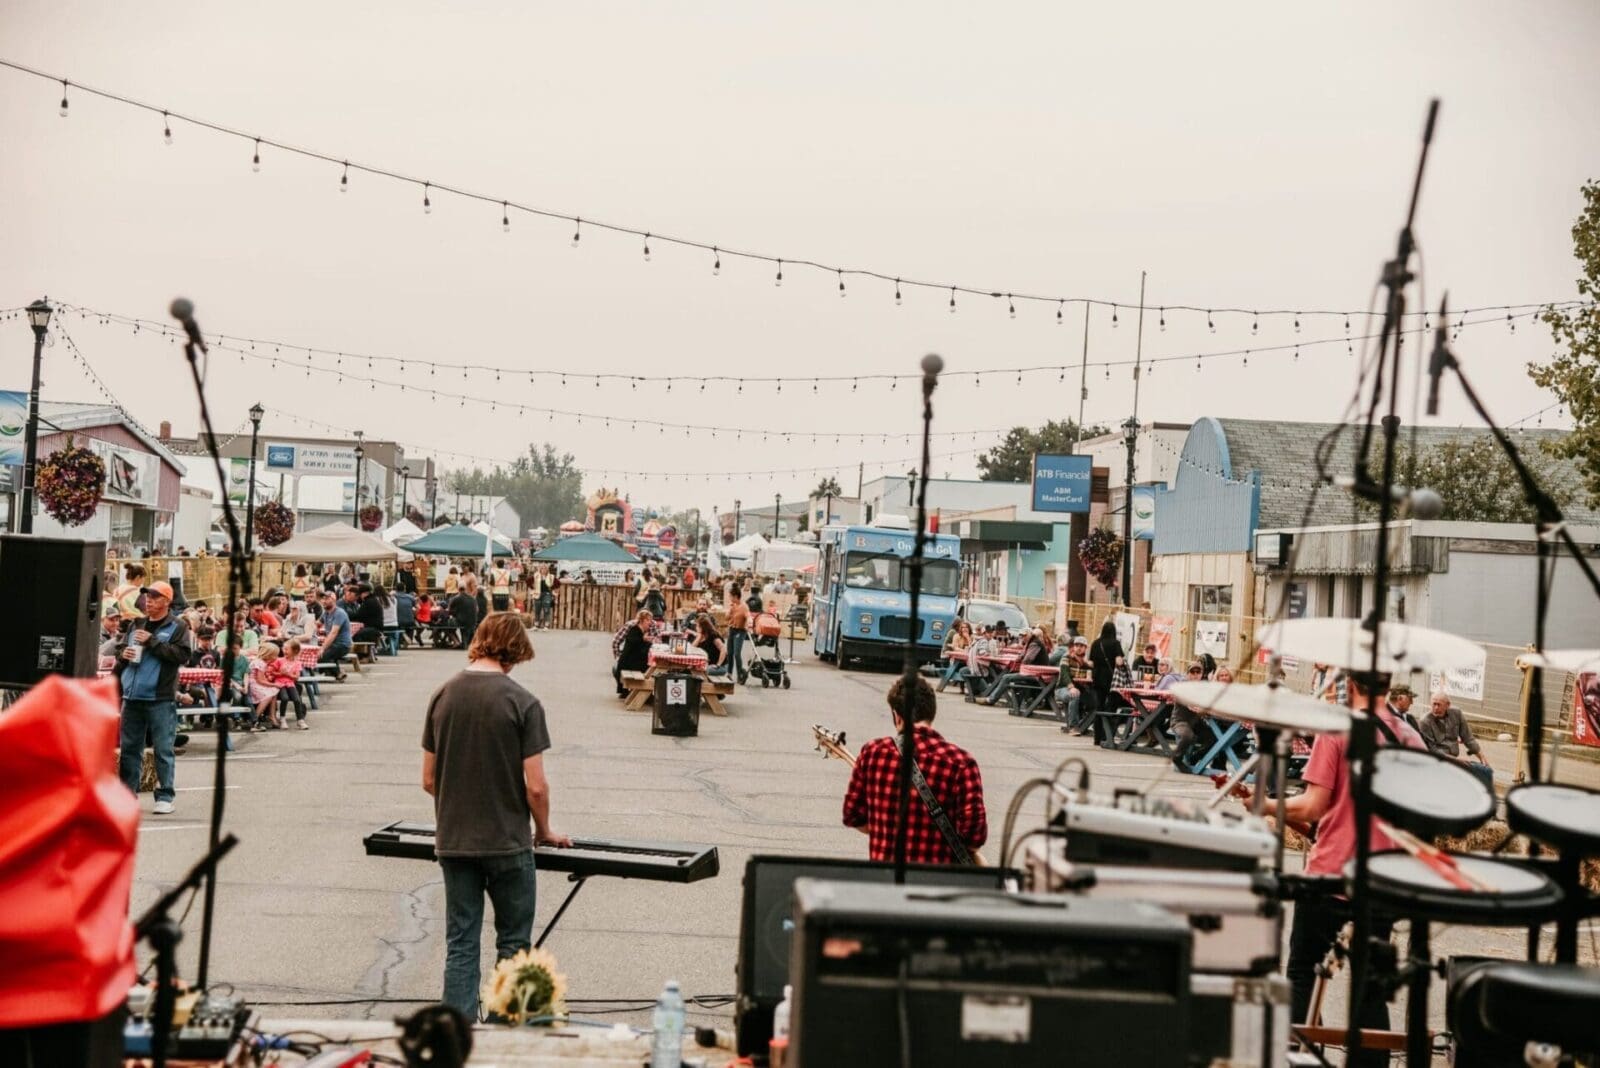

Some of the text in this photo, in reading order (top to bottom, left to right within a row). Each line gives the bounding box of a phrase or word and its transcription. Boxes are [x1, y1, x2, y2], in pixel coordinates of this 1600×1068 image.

[274, 453, 289, 461] Ford
[303, 460, 326, 468] SERVICE
[1036, 469, 1091, 480] ATB Financial
[1041, 494, 1083, 503] MasterCard
[897, 540, 912, 551] On
